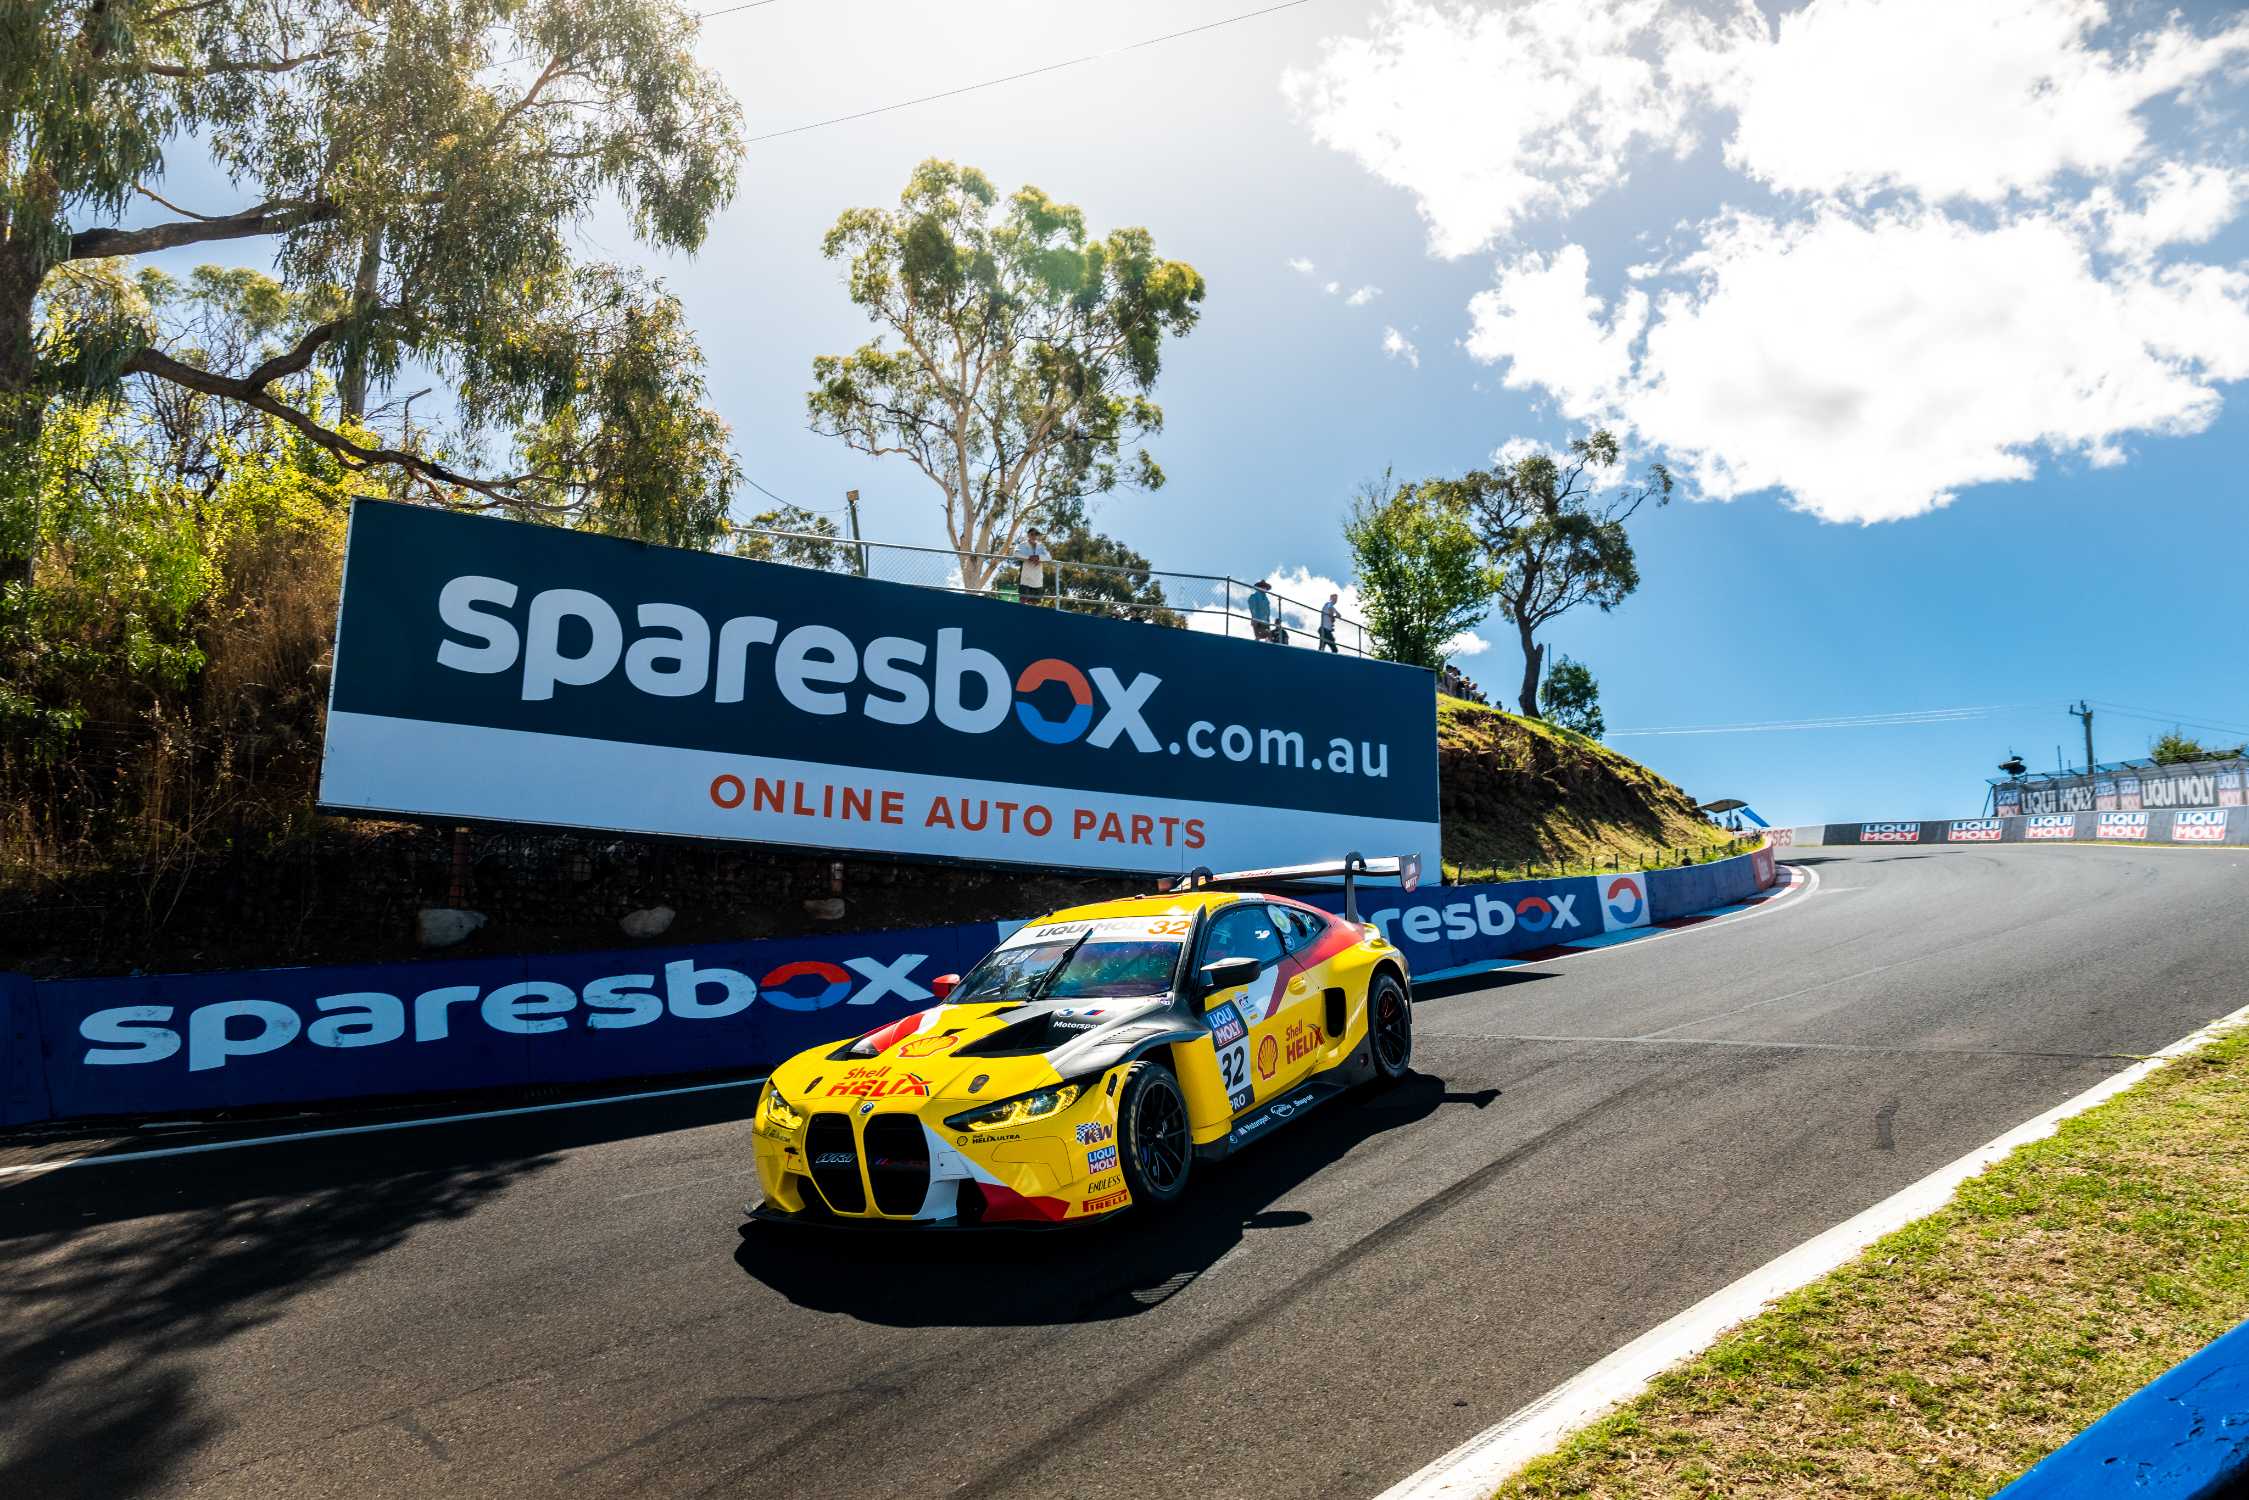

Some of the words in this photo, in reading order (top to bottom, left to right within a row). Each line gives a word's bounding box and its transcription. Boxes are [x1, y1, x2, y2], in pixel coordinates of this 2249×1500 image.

[2022, 790, 2056, 813] LIQUI
[2060, 786, 2095, 811] MOLY
[2143, 779, 2176, 806] LIQUI
[2180, 776, 2214, 805] MOLY
[710, 773, 904, 825] ONLINE
[925, 796, 1053, 836] AUTO
[1073, 808, 1206, 849] PARTS
[2101, 814, 2145, 825] LIQUI
[2178, 812, 2224, 825] LIQUI
[1865, 823, 1917, 833] LIQUI
[1953, 820, 1999, 830] LIQUI
[2030, 816, 2072, 826] LIQUI
[1864, 832, 1916, 840] MOLY
[1951, 830, 1998, 839] MOLY
[2029, 827, 2072, 837] MOLY
[2100, 826, 2145, 837] MOLY
[2175, 825, 2224, 838] MOLY
[1148, 920, 1191, 936] 32
[80, 953, 934, 1072] sparesbox
[1209, 1005, 1235, 1028] LIQUI
[1216, 1021, 1242, 1044] MOLY
[1286, 1019, 1303, 1041] Shell
[1286, 1024, 1325, 1064] HELIX
[844, 1066, 892, 1079] Shell
[1222, 1046, 1245, 1090] 32
[826, 1073, 933, 1097] HELIX
[1089, 1146, 1115, 1163] LIQUI
[1090, 1157, 1117, 1174] MOLY
[1088, 1175, 1121, 1194] ENDLESS
[1082, 1189, 1128, 1212] PIRELLI
